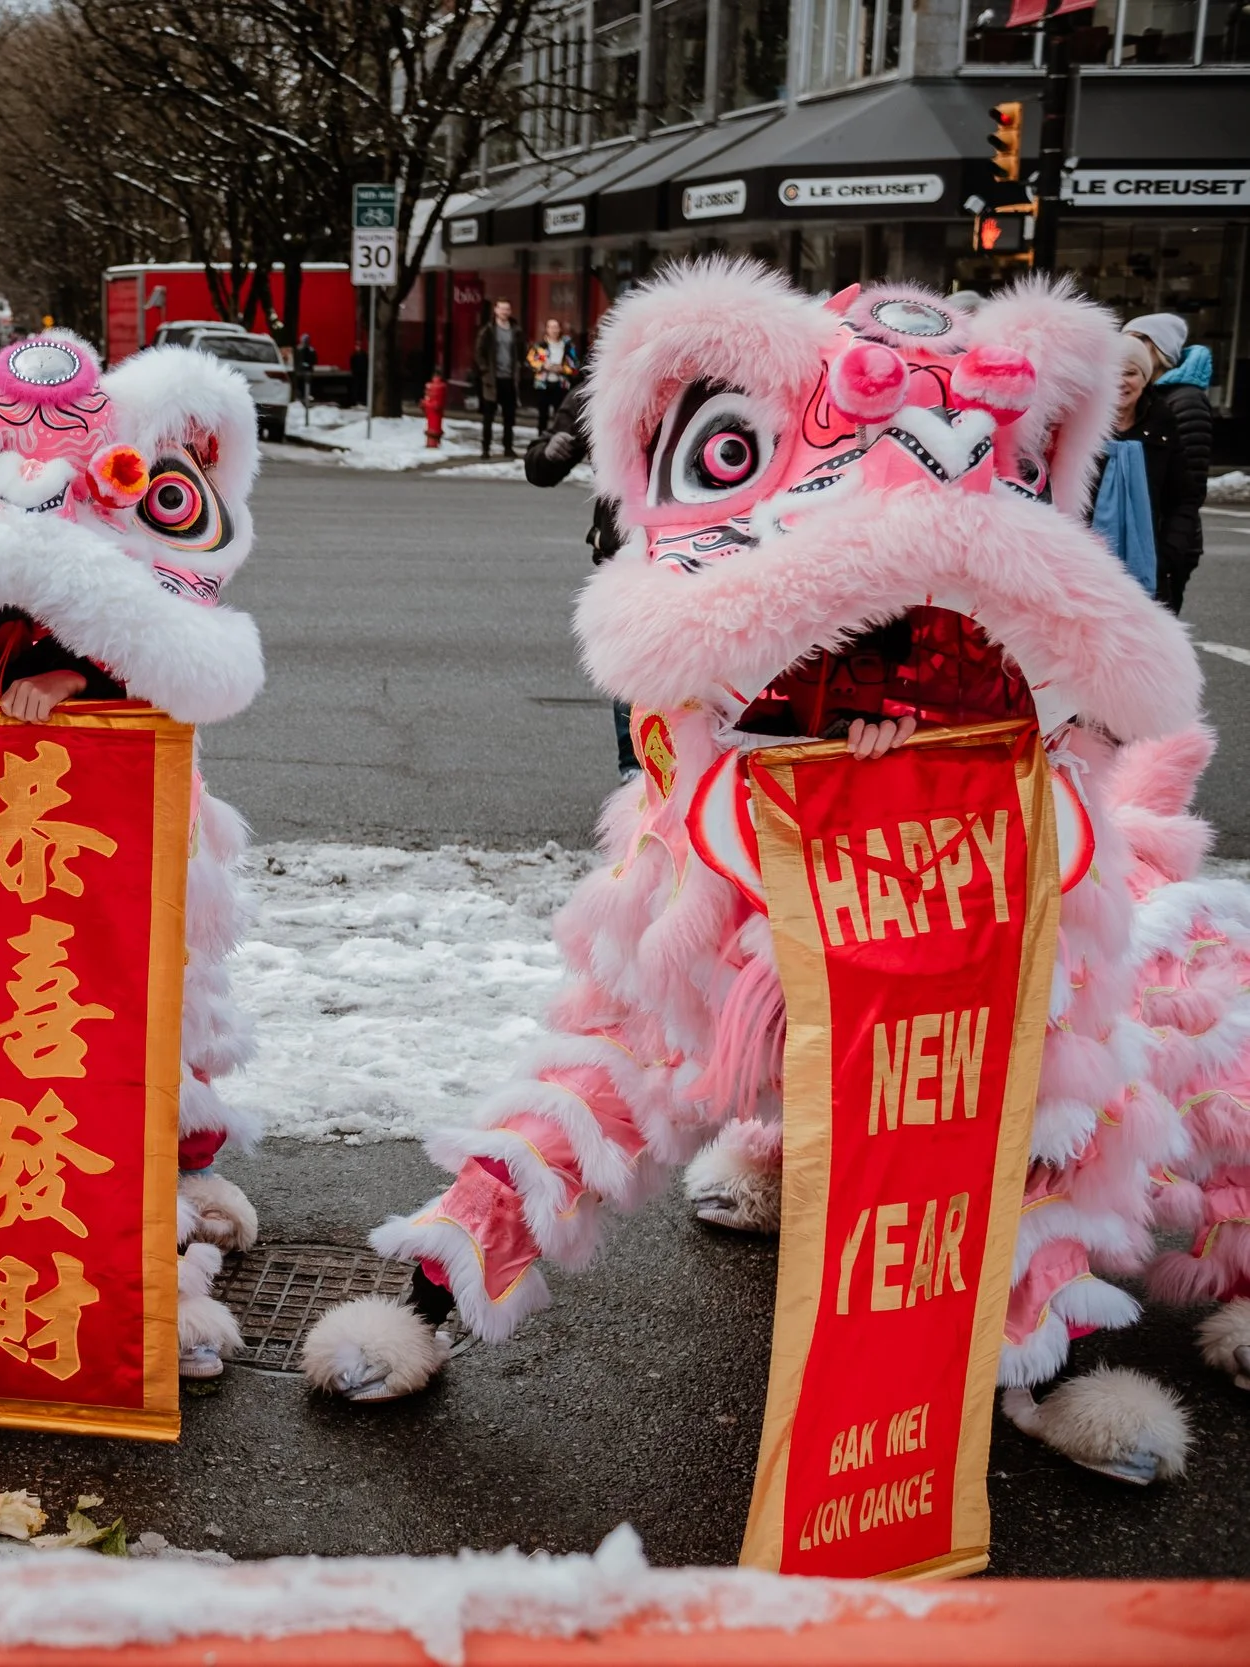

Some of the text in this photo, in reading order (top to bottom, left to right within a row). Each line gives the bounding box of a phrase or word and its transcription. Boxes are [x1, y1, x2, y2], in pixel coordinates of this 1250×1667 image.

[810, 182, 928, 197] LE CREUSET
[1072, 179, 1246, 195] LE CREUSET
[358, 245, 391, 268] 30
[811, 810, 1010, 946] HAPPY
[868, 1007, 989, 1135] NEW
[836, 1192, 969, 1315] YEAR
[829, 1403, 929, 1476] BAK MEI
[799, 1469, 935, 1551] LION DANCE
